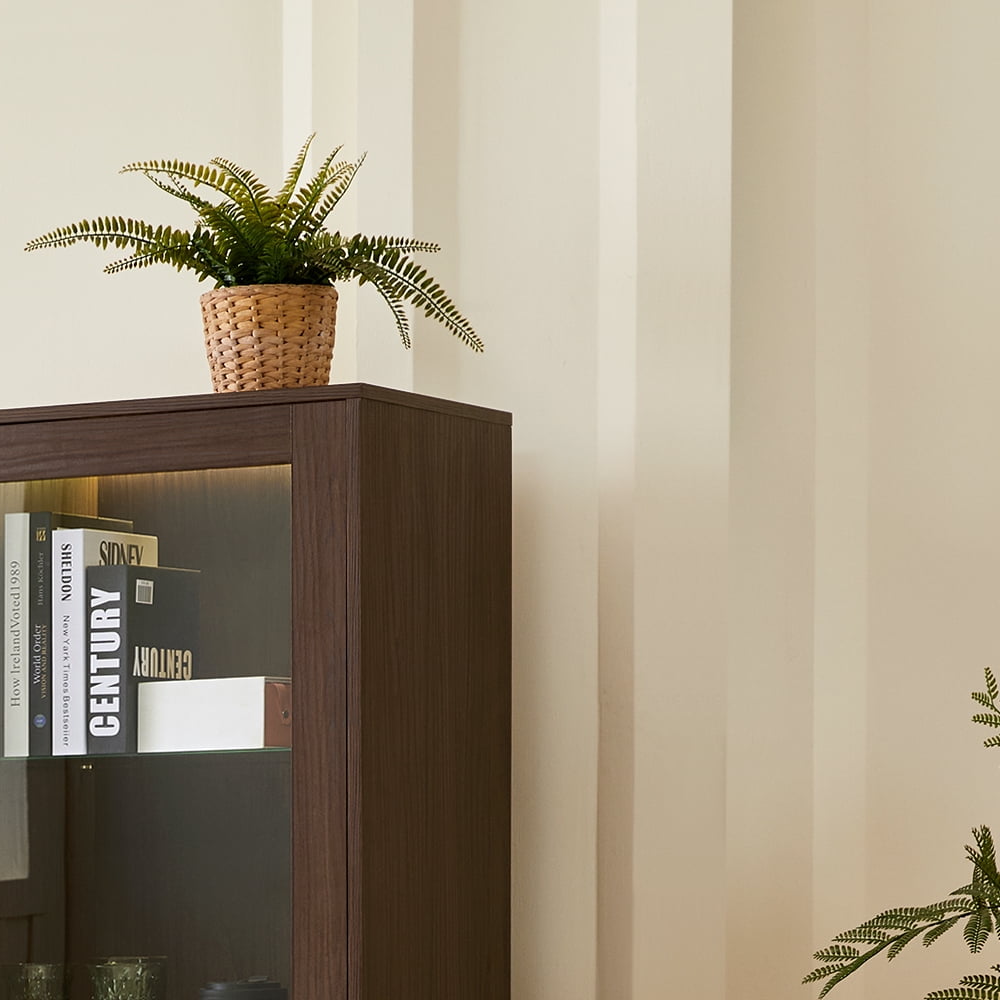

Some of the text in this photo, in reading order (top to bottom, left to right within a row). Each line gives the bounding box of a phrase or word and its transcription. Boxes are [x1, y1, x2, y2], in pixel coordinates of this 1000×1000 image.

[60, 543, 72, 601] SHELDON
[62, 615, 70, 637] New
[32, 623, 41, 685] World Order
[89, 587, 121, 737] CENTURY
[132, 646, 192, 681] CENTURY
[9, 677, 21, 707] How
[62, 663, 70, 694] Times
